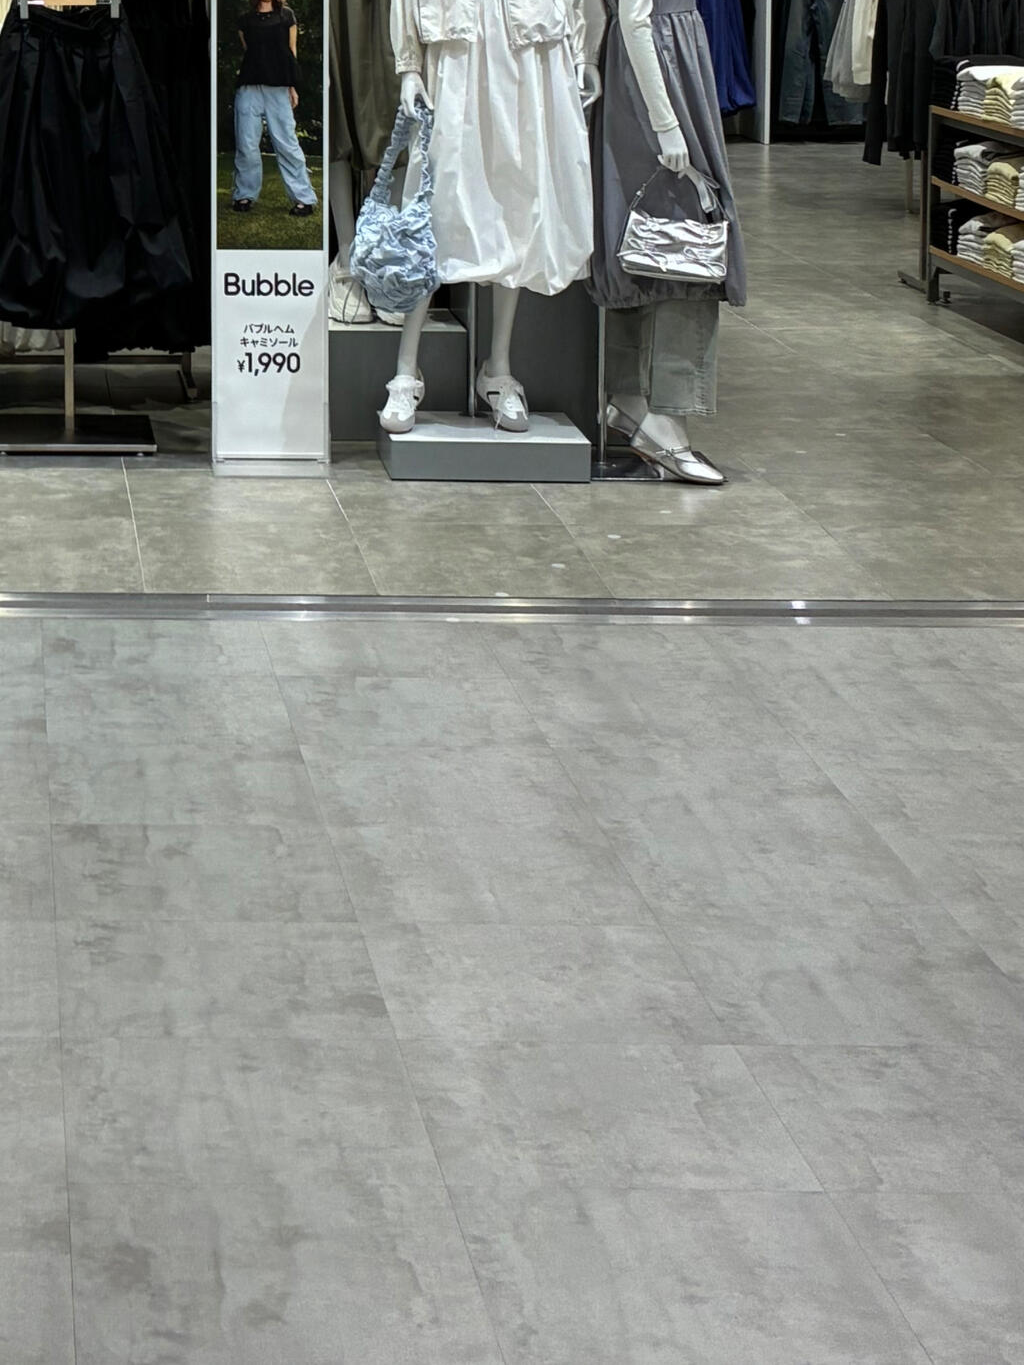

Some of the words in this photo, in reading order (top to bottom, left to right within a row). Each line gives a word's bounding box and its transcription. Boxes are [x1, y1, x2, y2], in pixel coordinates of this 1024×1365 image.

[224, 272, 315, 297] Bubble
[243, 323, 295, 334] バブルヘム
[240, 337, 299, 348] キャミソール
[237, 352, 301, 377] ¥1,990
